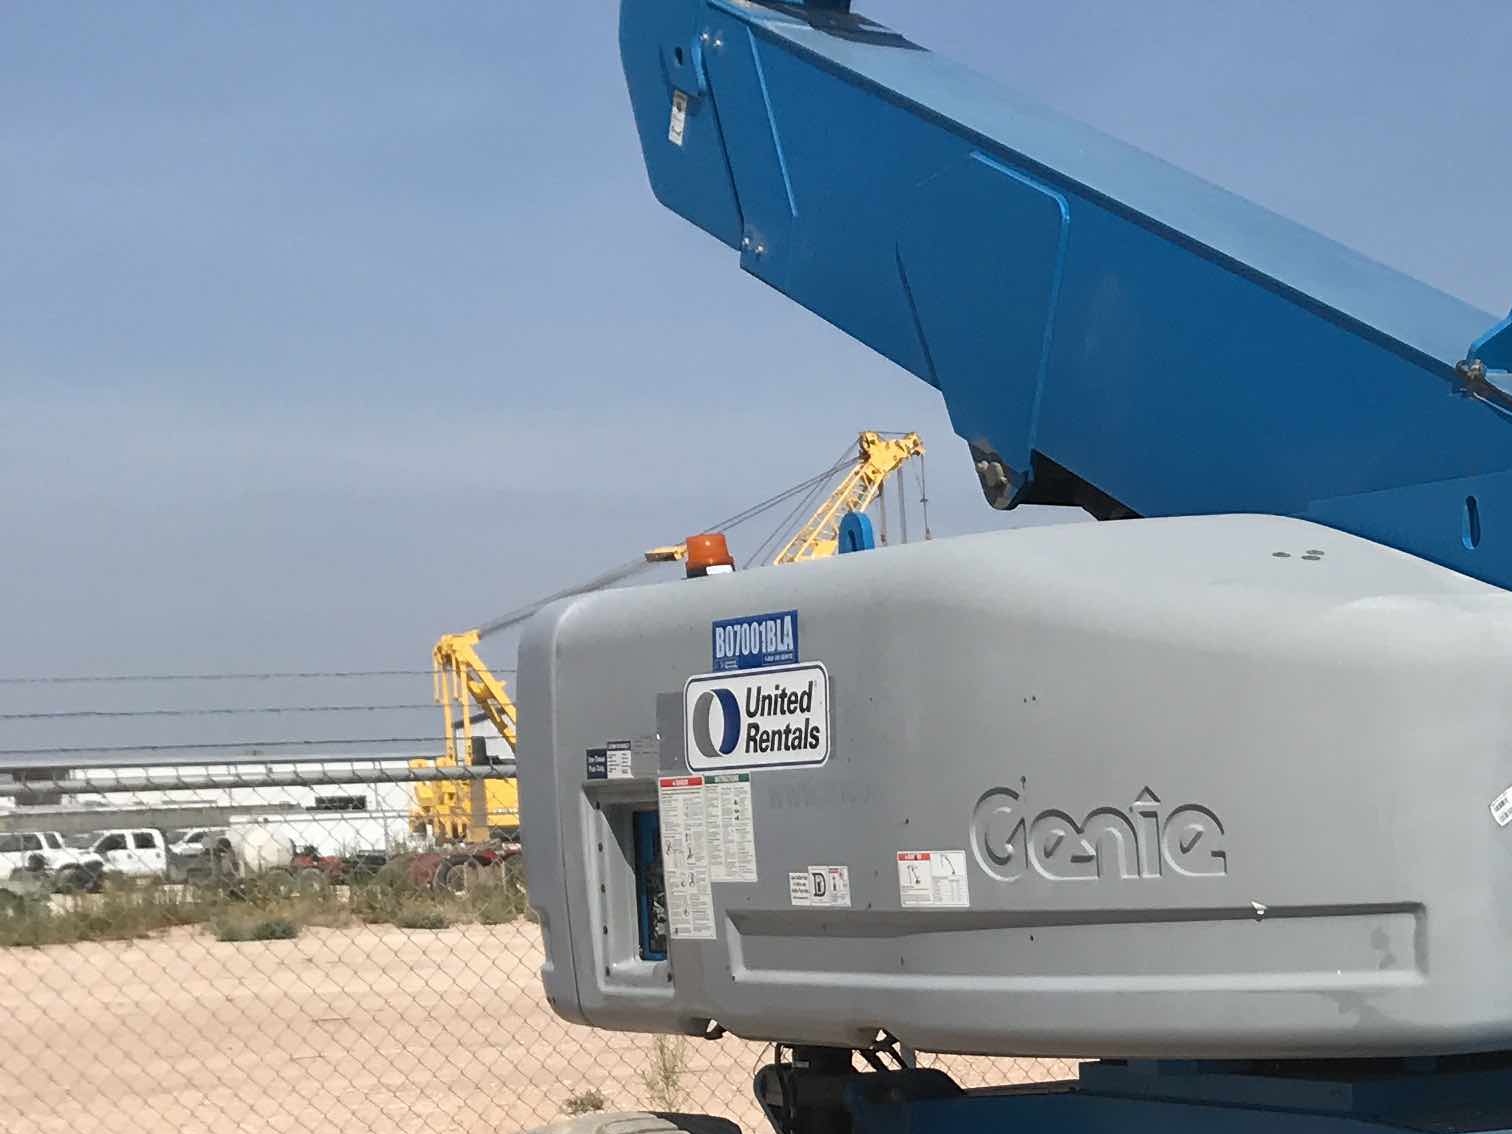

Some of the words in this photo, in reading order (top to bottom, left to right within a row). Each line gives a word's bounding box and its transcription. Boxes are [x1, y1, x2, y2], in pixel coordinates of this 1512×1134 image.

[745, 680, 814, 718] United
[745, 717, 820, 753] Rentals
[969, 785, 1228, 882] Genie
